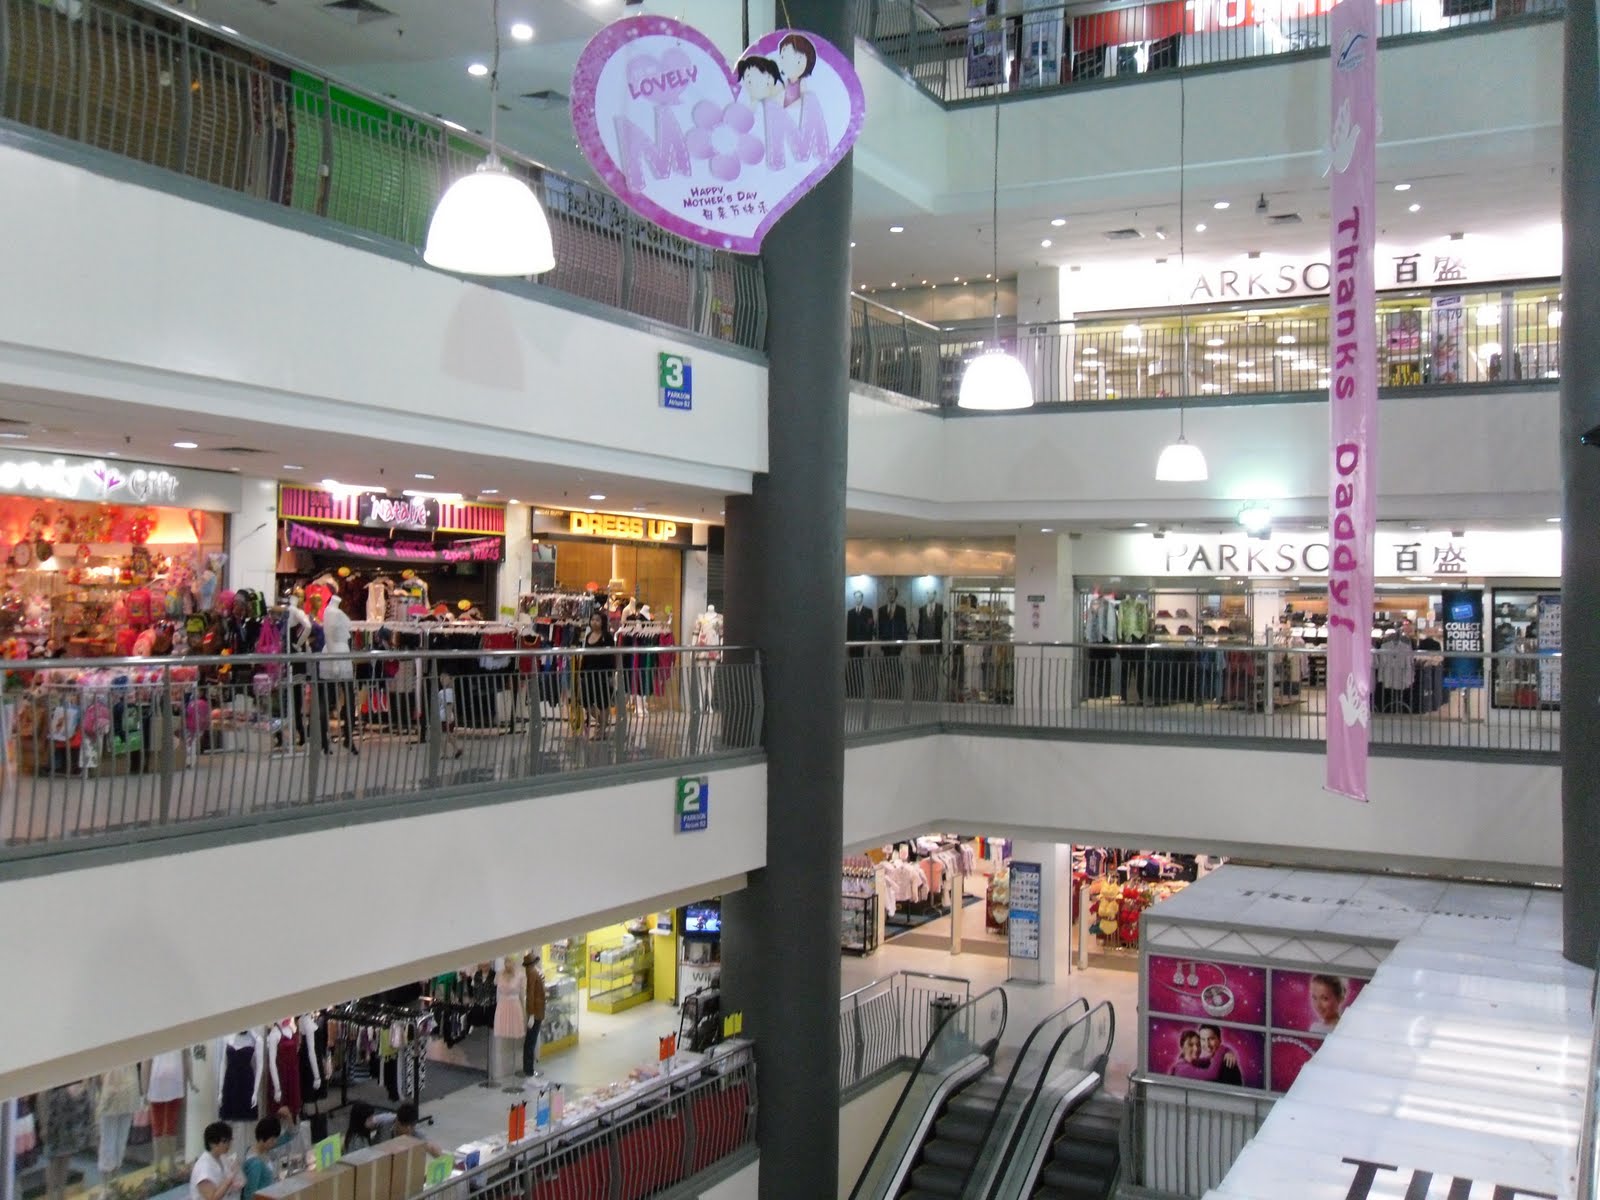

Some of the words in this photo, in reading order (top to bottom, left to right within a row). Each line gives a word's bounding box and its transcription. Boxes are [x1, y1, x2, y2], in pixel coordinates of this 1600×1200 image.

[628, 65, 698, 99] LOVELY
[691, 187, 724, 198] HAPPY
[737, 191, 757, 201] DAY
[1190, 262, 1332, 300] ARKSO
[1335, 206, 1360, 400] Thanks
[666, 357, 683, 388] 3
[570, 511, 643, 539] DRESS
[648, 520, 677, 541] UP
[1329, 443, 1358, 634] Daddy!
[1166, 543, 1329, 573] PARKSO
[1392, 542, 1468, 574] 百盛
[1445, 622, 1480, 631] COLLECT
[1447, 631, 1480, 639] POINTS
[1446, 640, 1480, 651] HERE!
[683, 781, 700, 811] 2
